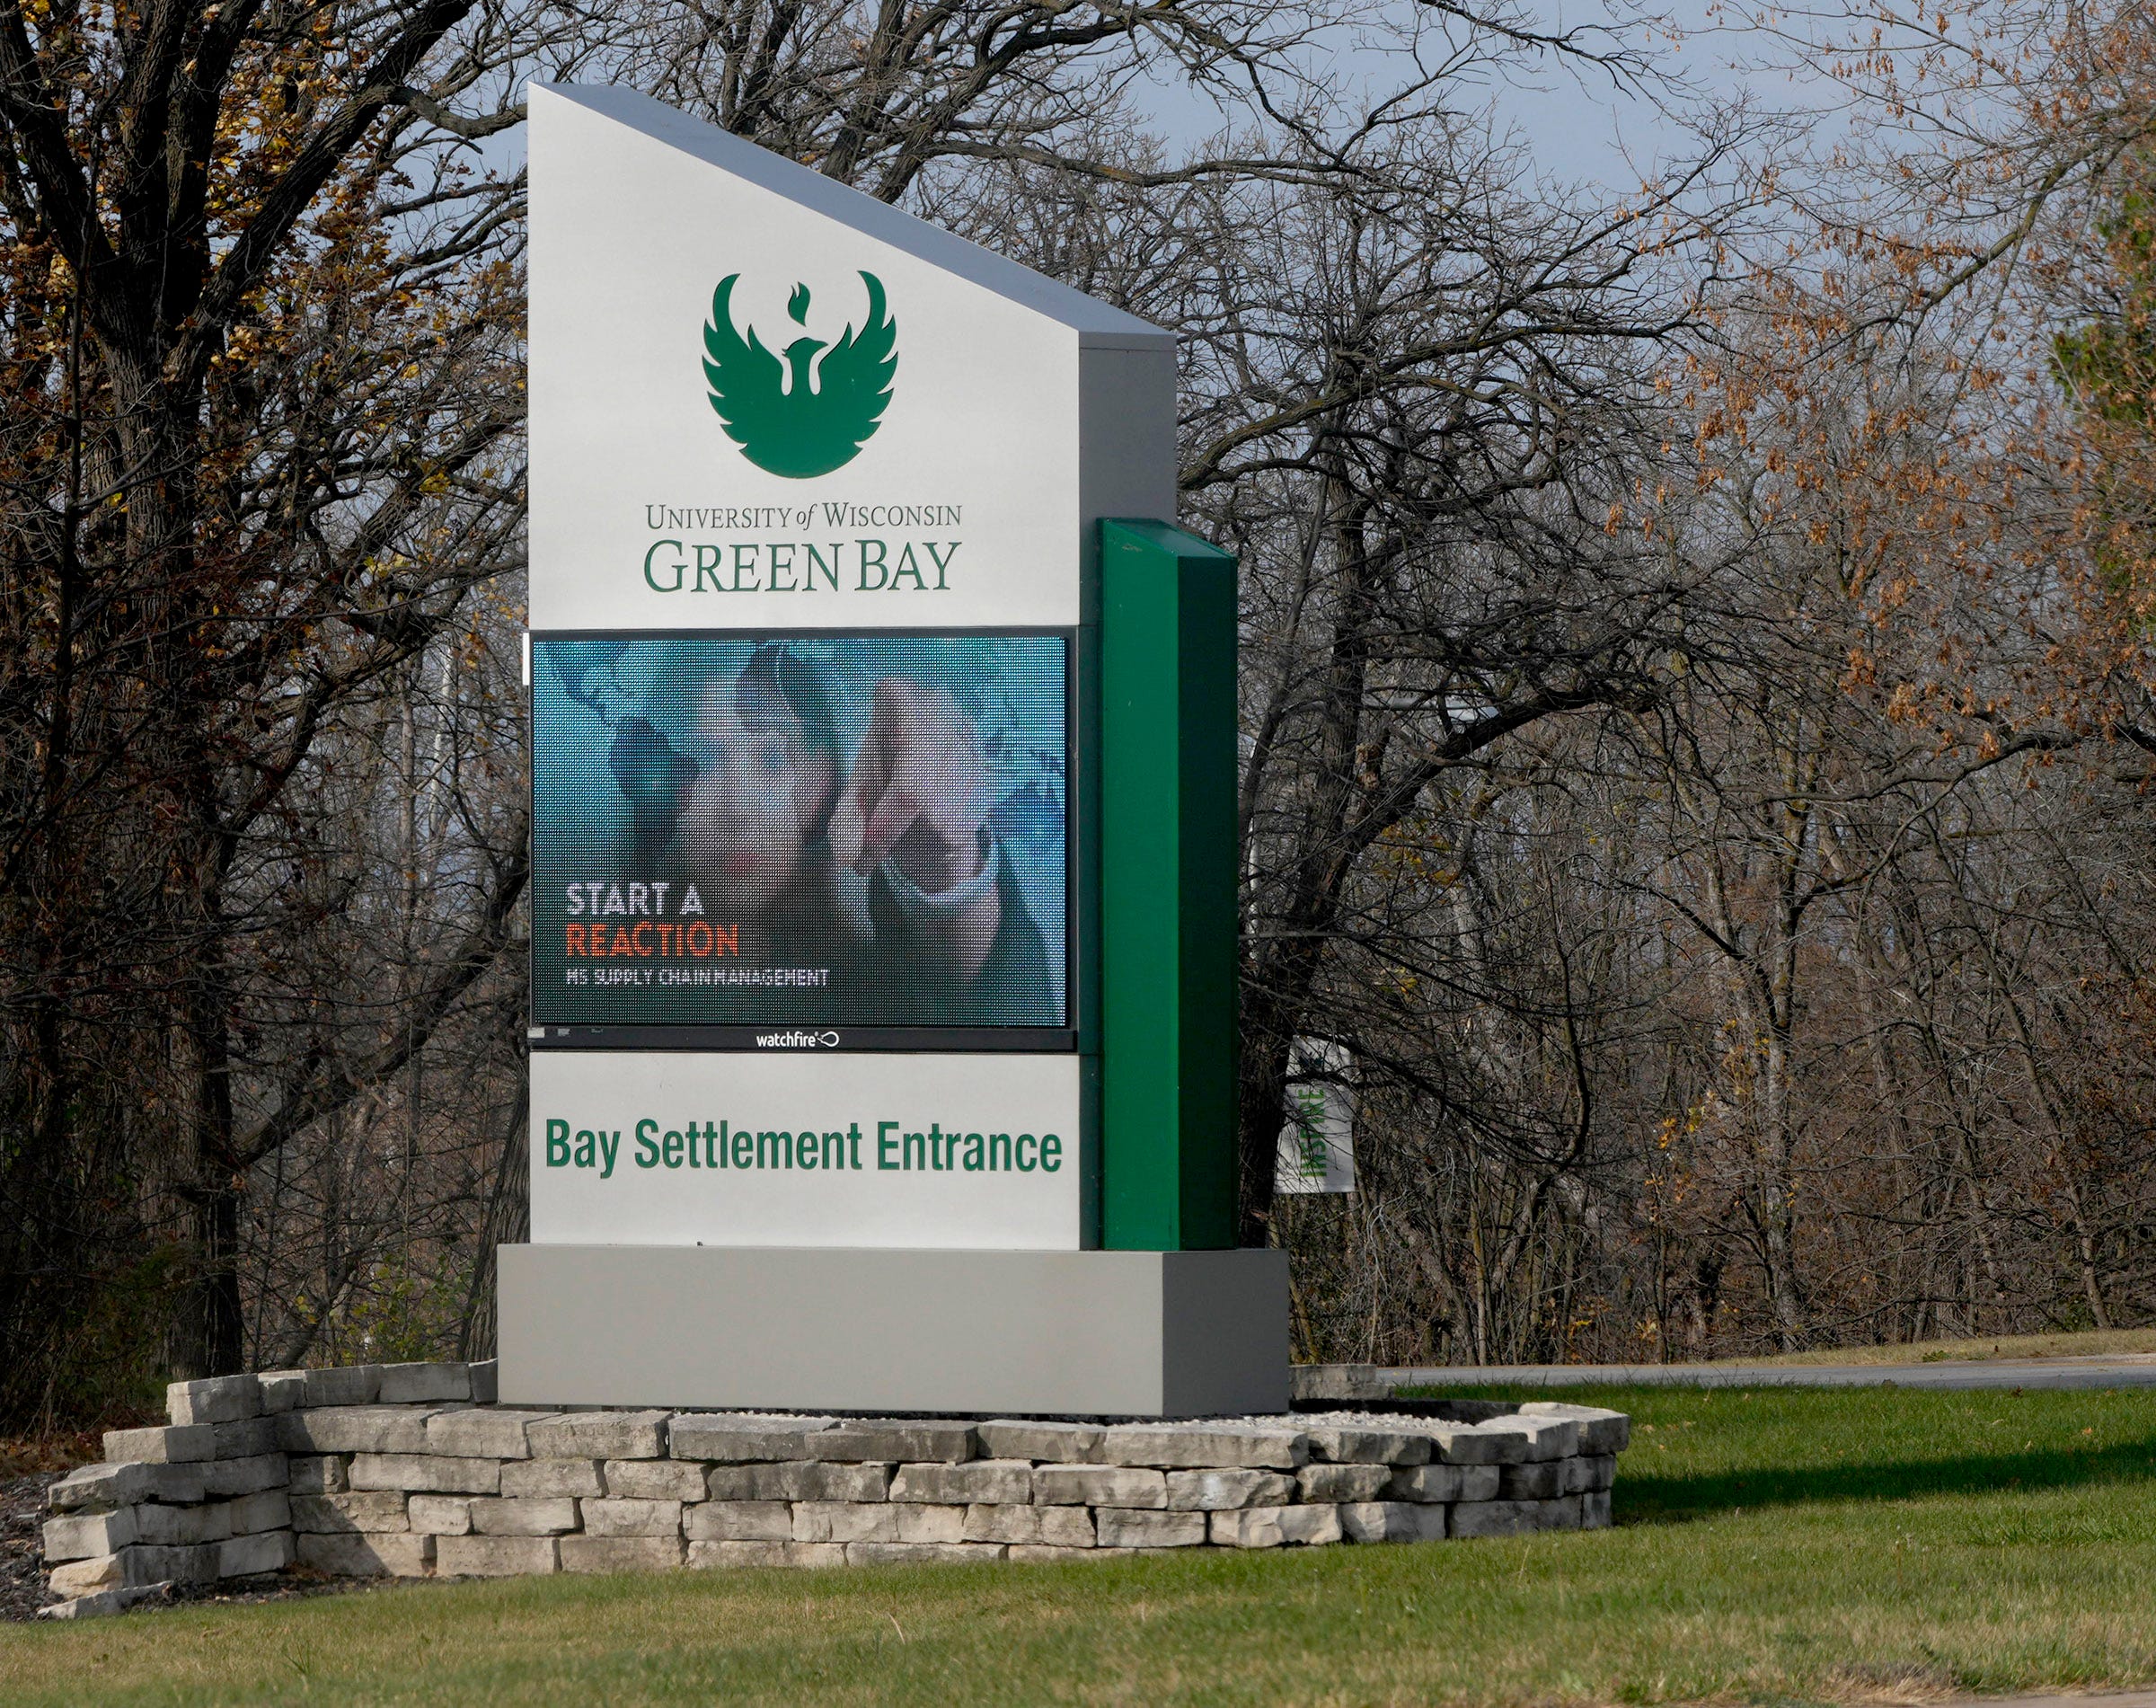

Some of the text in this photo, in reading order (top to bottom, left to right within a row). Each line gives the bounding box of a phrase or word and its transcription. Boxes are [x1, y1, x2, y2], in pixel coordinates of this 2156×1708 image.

[646, 502, 962, 529] UNIVERSITY of WISCONSIN
[644, 540, 962, 593] GREEN BAY
[567, 883, 704, 915] START A
[567, 921, 738, 957] REACTION
[566, 969, 830, 987] MS SUPPLY CHAIN MANAGEMENT
[756, 1031, 816, 1047] watchfire
[546, 1119, 1063, 1179] Bay Settlement Entrance
